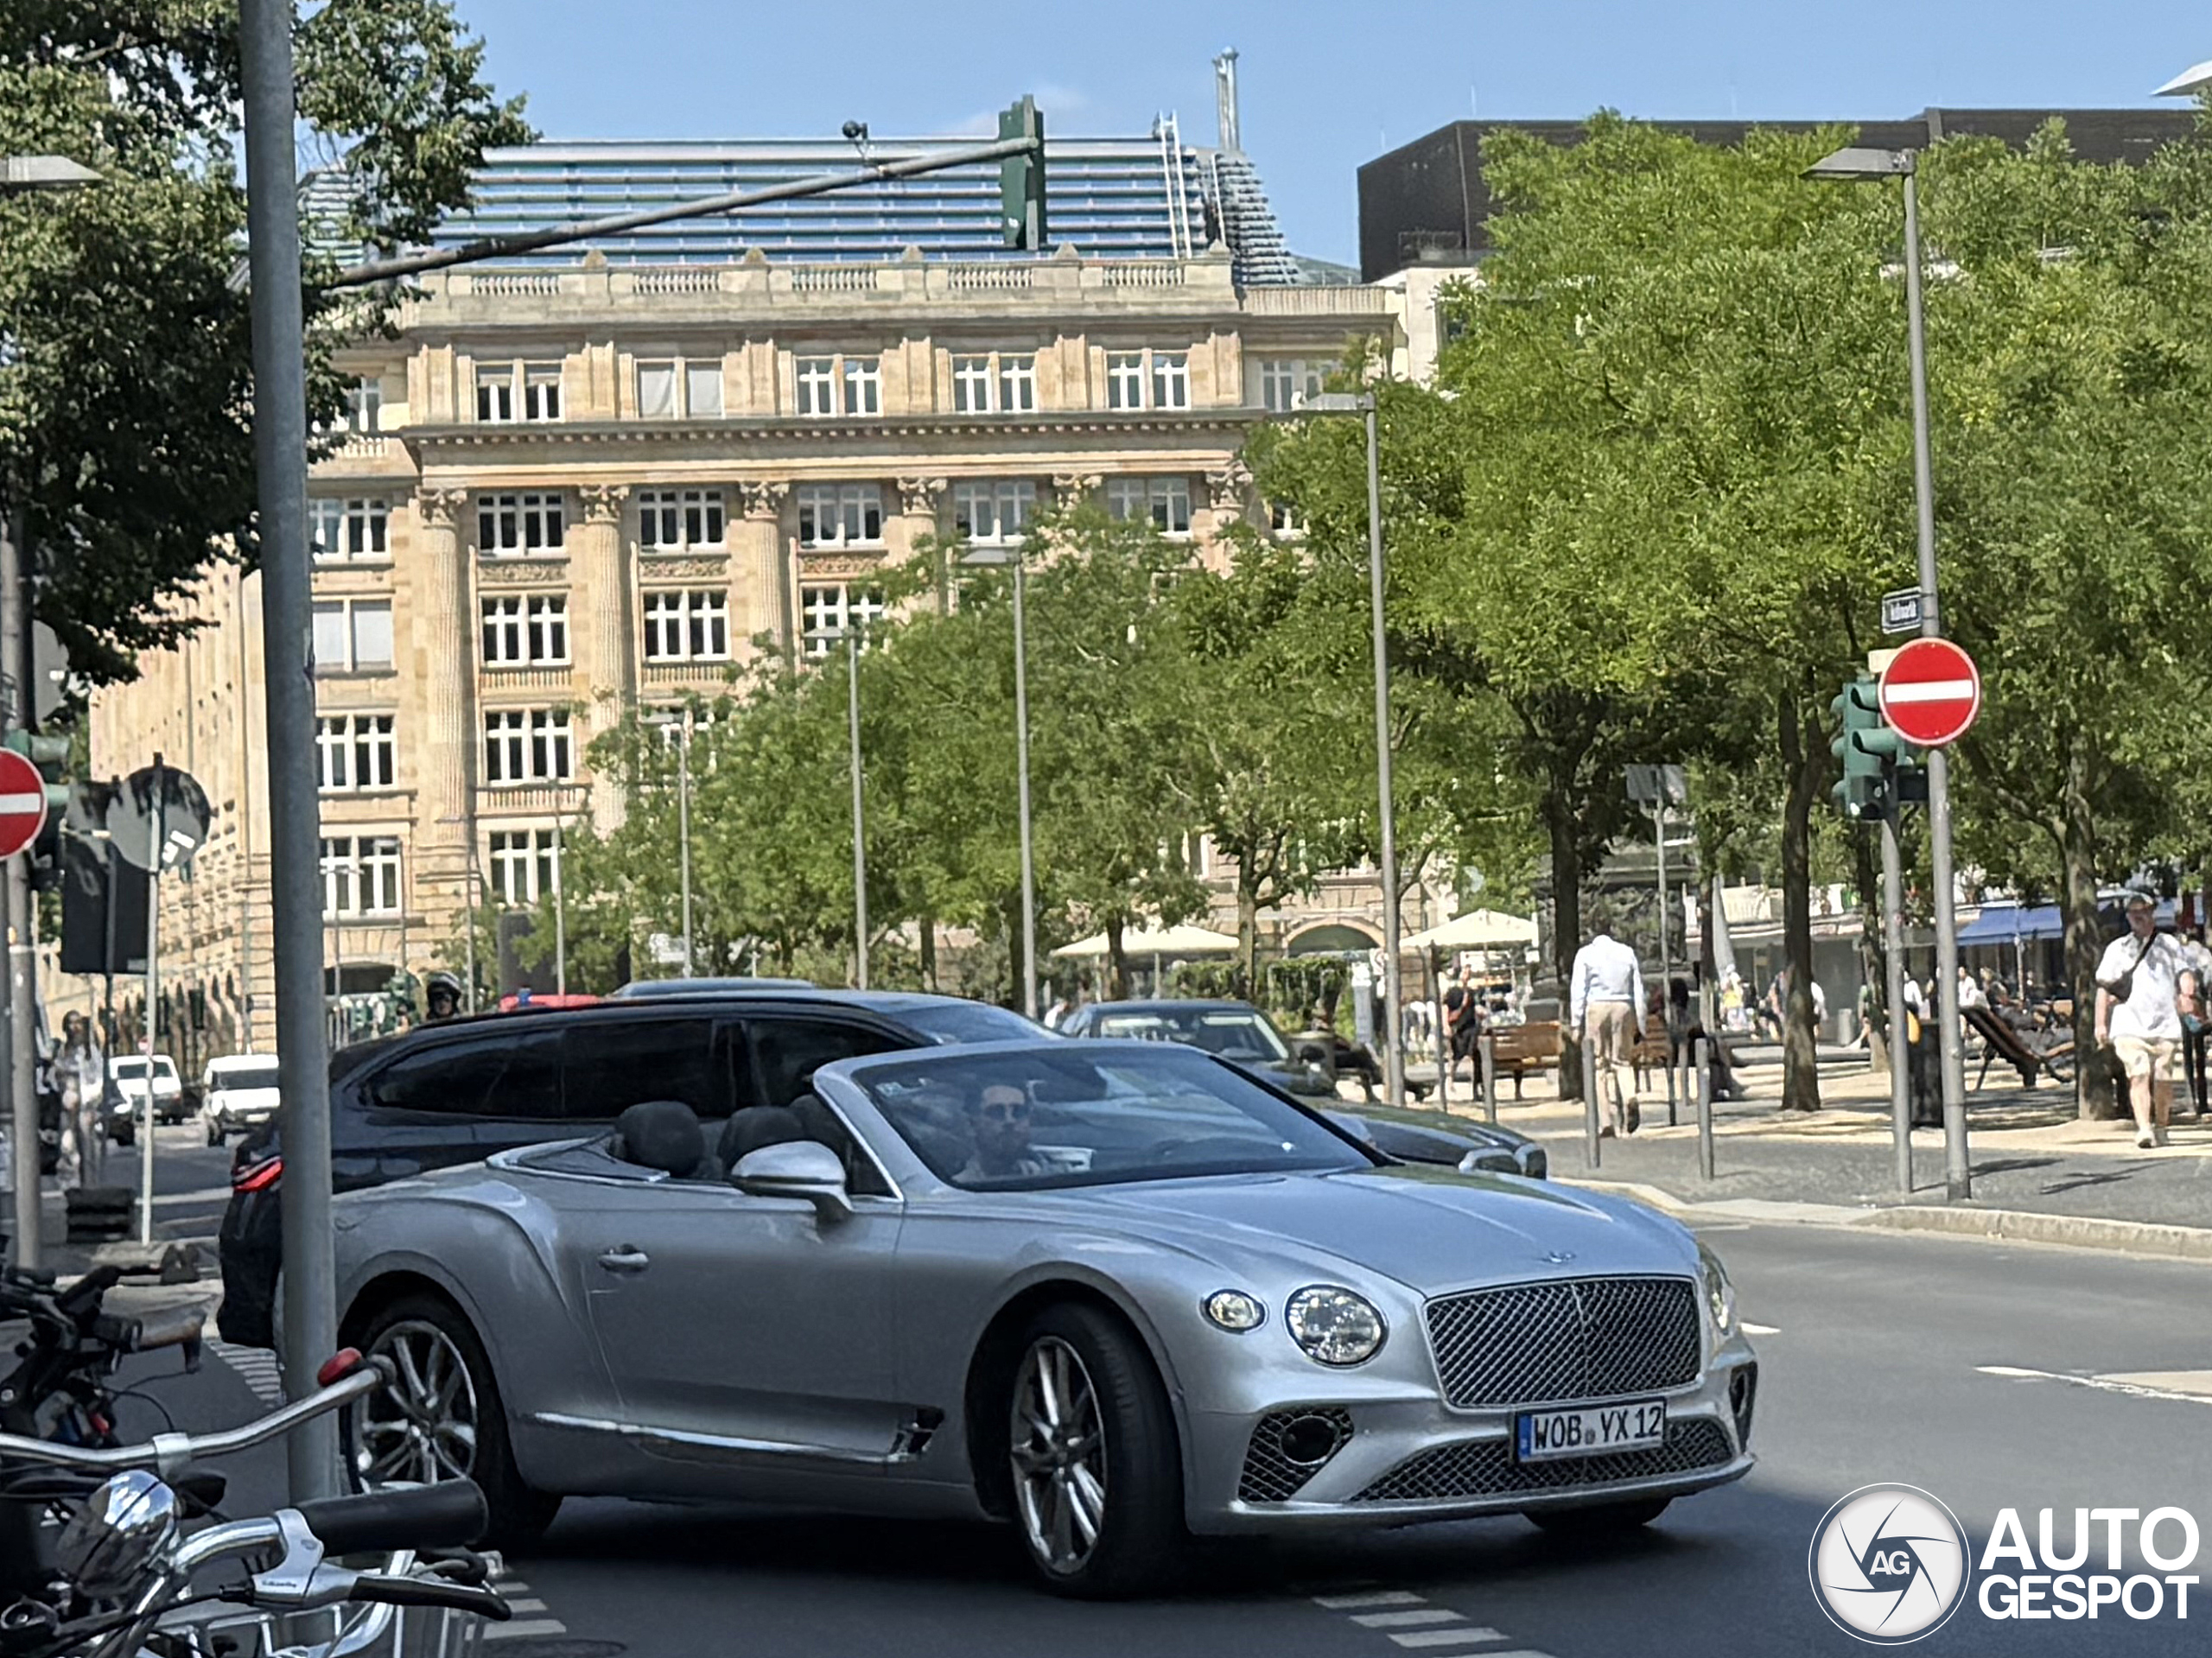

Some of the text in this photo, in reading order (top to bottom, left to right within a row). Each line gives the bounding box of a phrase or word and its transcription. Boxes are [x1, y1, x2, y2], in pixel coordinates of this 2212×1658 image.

[1534, 1406, 1662, 1450] WOB YX 12
